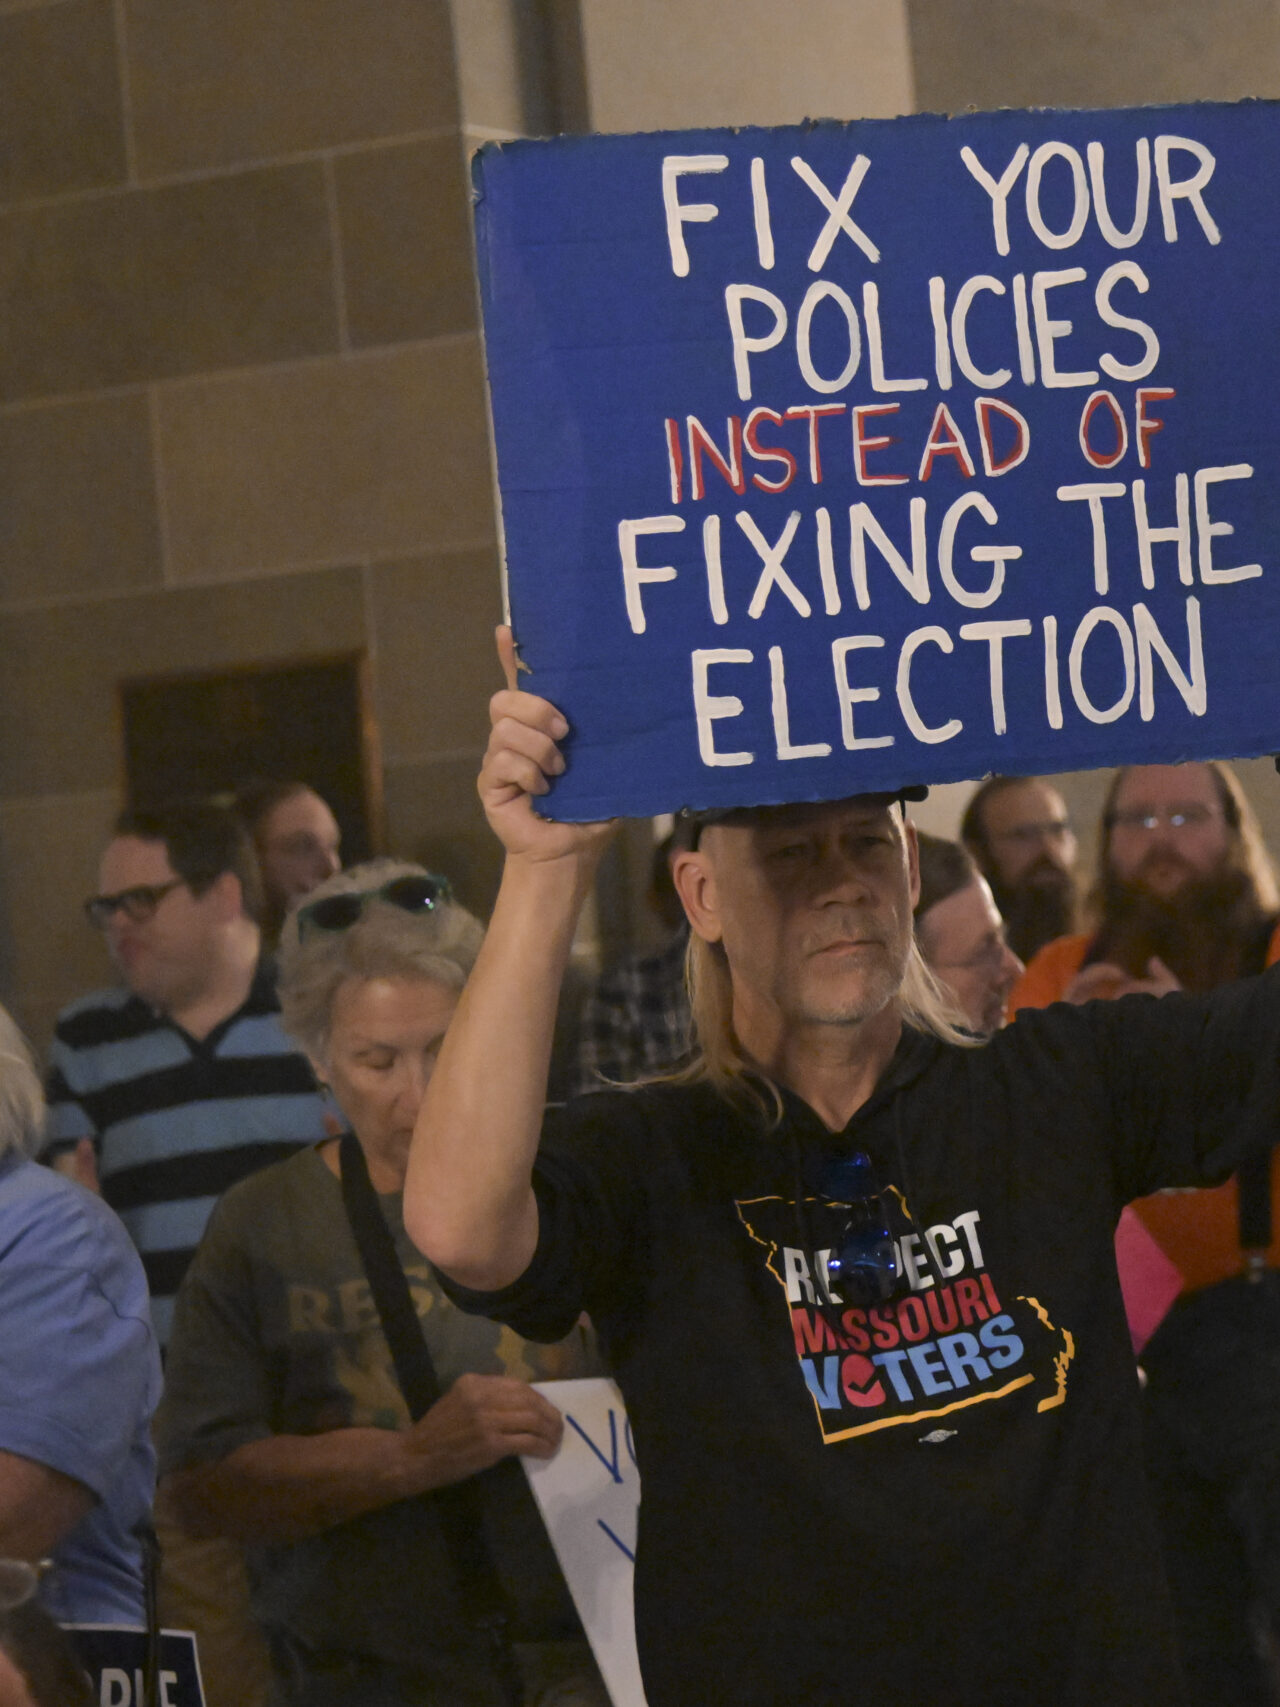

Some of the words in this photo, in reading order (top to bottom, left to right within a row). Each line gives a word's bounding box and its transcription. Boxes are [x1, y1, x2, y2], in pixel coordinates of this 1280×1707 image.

[661, 153, 881, 278] FIX
[960, 134, 1222, 257] YOUR
[725, 260, 1160, 401] POLICIES
[664, 397, 1030, 503] INSTEAD
[1078, 387, 1175, 468] OF
[618, 491, 1022, 635] FIXING
[1056, 464, 1263, 595] THE
[692, 597, 1207, 768] ELECTION
